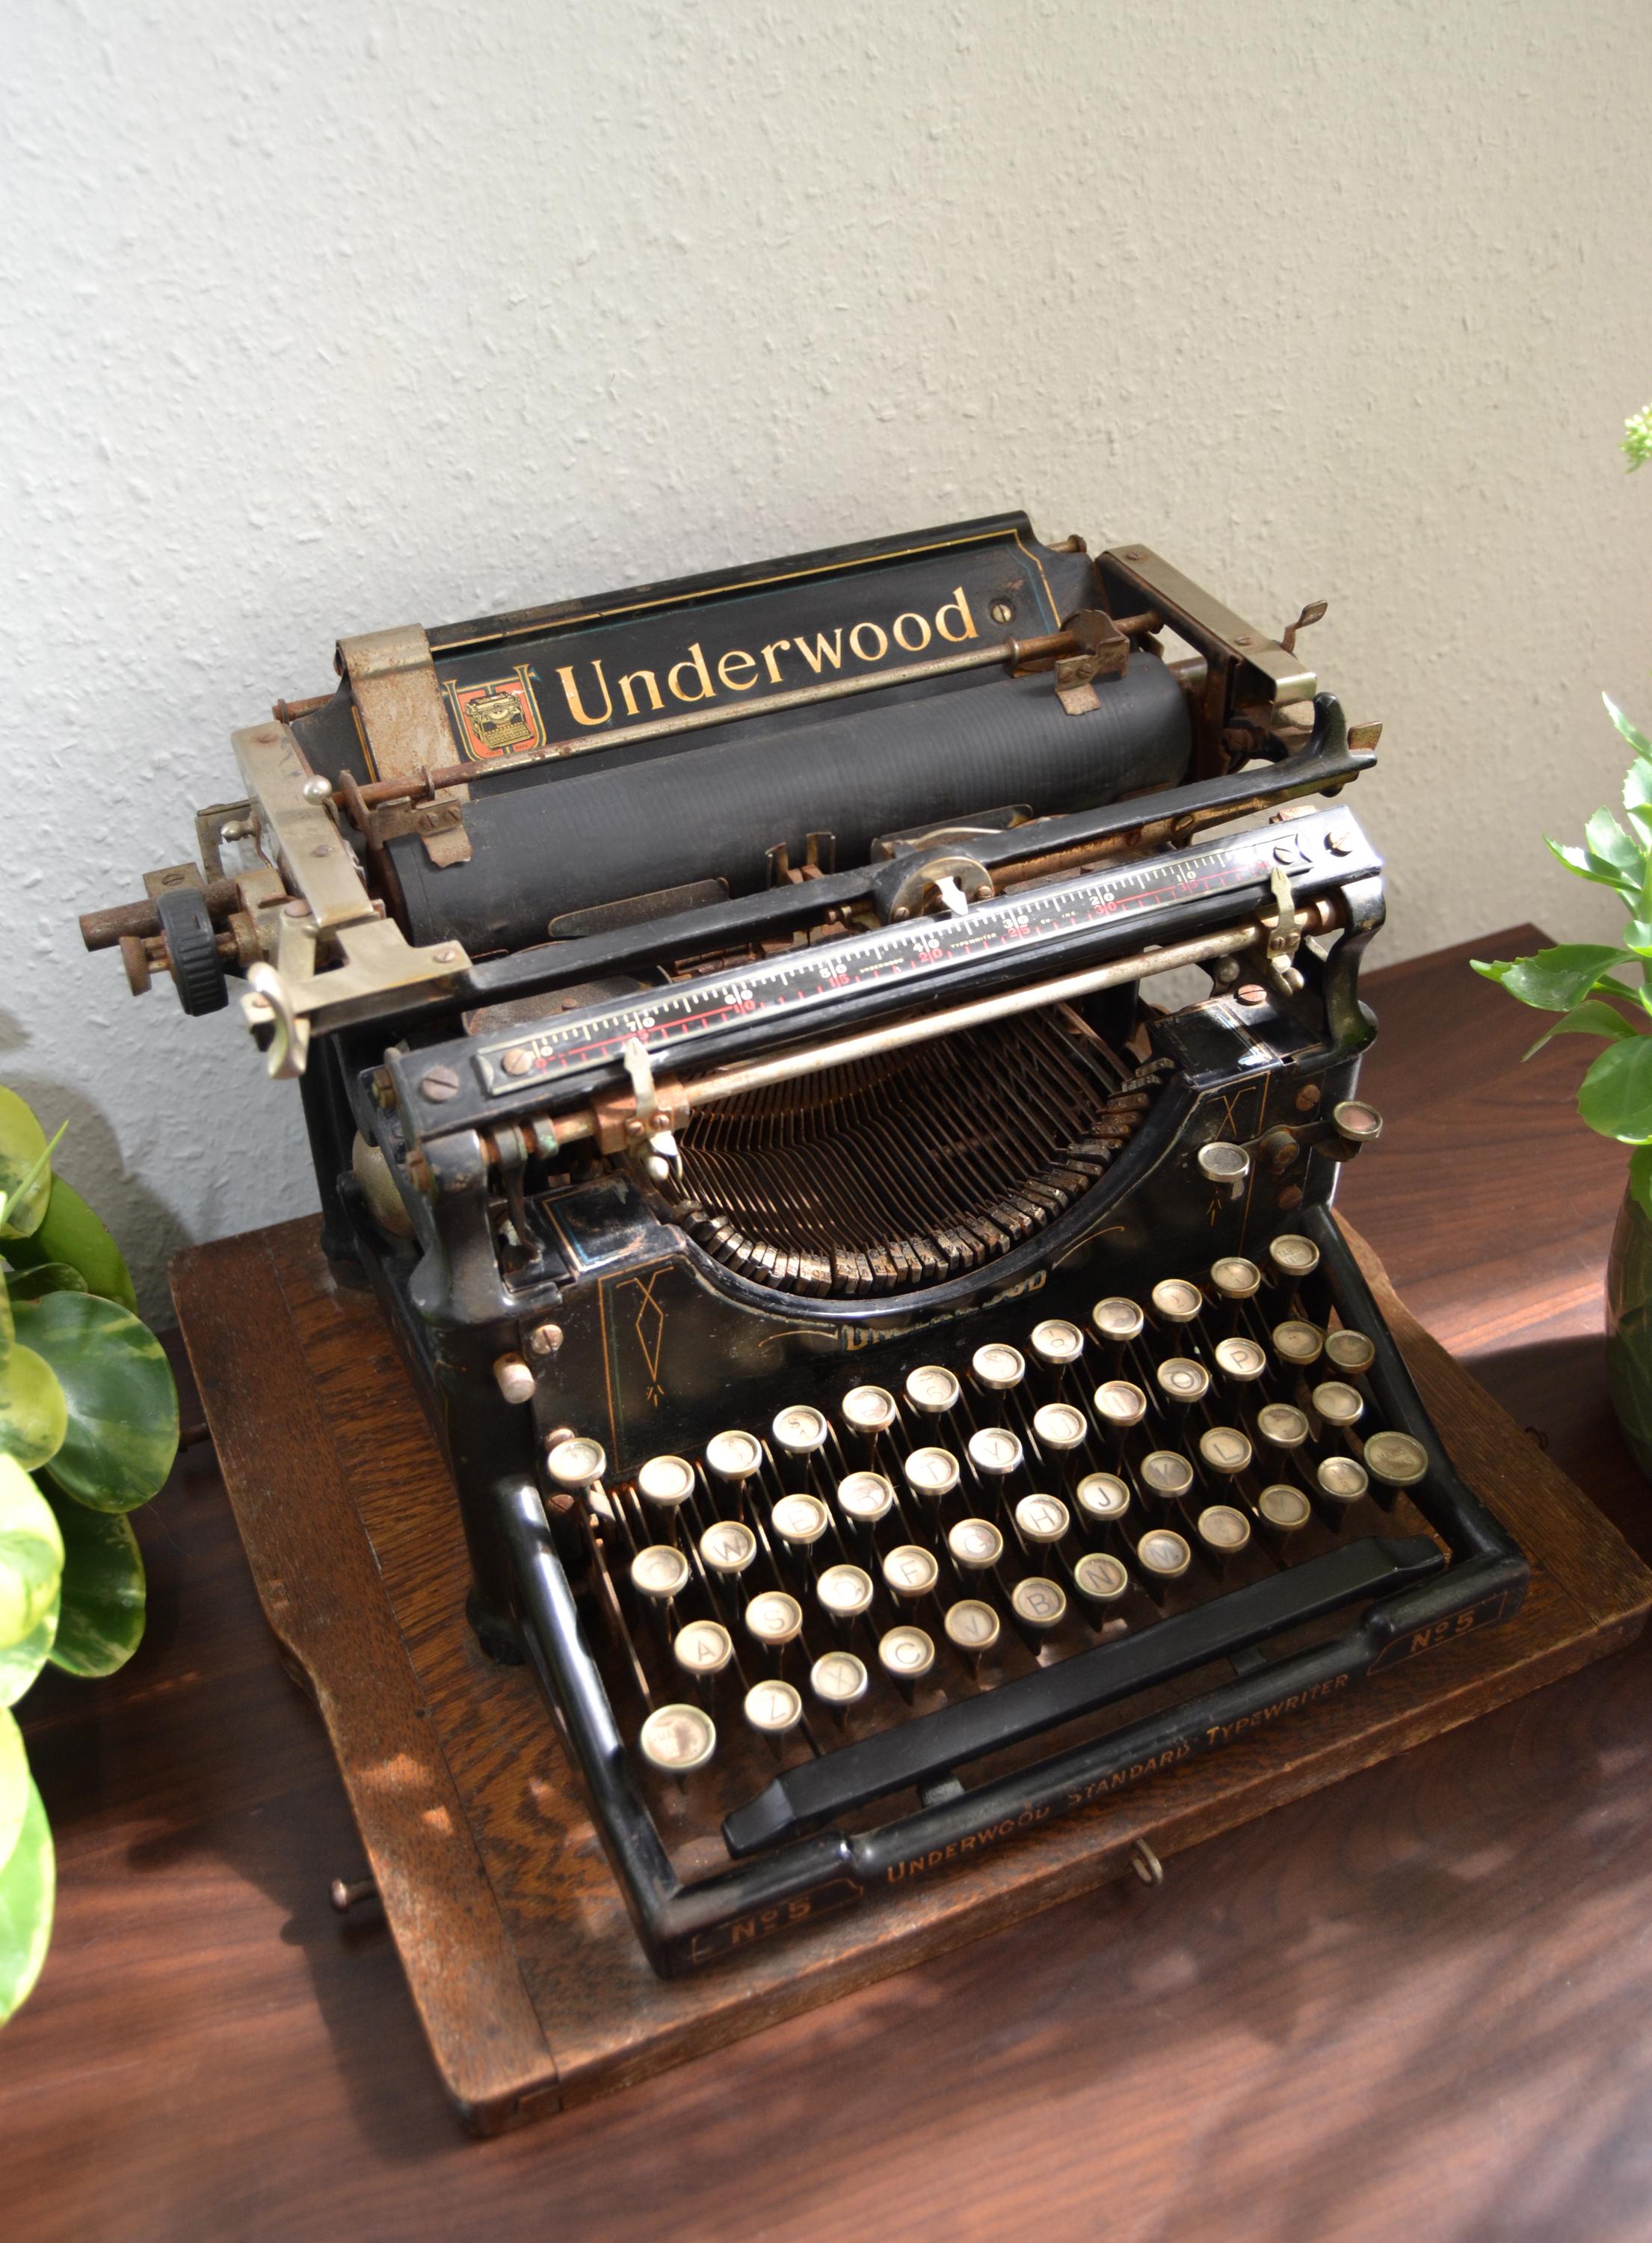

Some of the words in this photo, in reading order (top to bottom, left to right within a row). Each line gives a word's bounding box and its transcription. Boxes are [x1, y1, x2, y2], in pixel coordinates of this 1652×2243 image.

[556, 586, 979, 725] Underwood
[1230, 1350, 1248, 1370] P
[1171, 1371, 1195, 1390] O
[983, 1441, 1002, 1461] Y
[1212, 1443, 1241, 1462] L
[918, 1460, 939, 1482] T
[1097, 1486, 1112, 1507] J
[787, 1508, 813, 1532] E
[1029, 1507, 1055, 1530] H
[712, 1536, 743, 1561] W
[900, 1559, 918, 1584] F
[1085, 1565, 1114, 1590] N
[1027, 1593, 1050, 1616] B
[764, 1609, 785, 1630] S
[697, 1640, 715, 1662] A
[895, 1642, 921, 1664] C
[827, 1665, 854, 1693] X
[1206, 1674, 1349, 1746] TYPEWRITER
